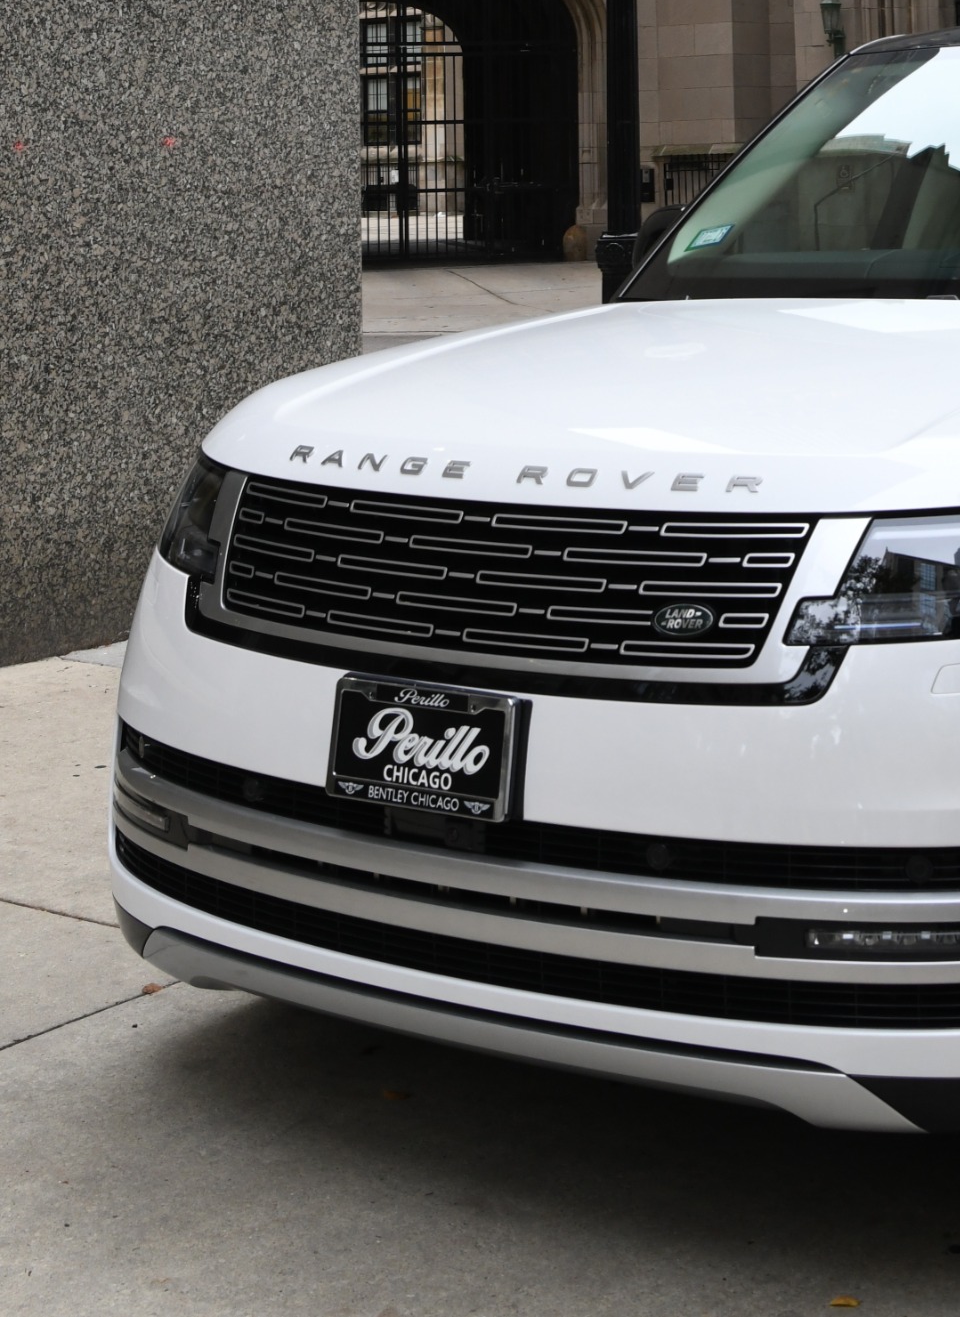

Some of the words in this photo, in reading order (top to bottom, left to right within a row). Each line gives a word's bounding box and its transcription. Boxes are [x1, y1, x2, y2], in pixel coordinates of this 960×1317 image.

[289, 444, 471, 480] RANGE
[516, 465, 764, 494] ROVER
[665, 609, 695, 618] LAND
[666, 619, 703, 628] ROVER
[394, 688, 450, 708] Perillo
[352, 707, 490, 775] Perillo
[382, 764, 452, 790] CHICAGO
[368, 785, 410, 804] BENTLEY
[411, 792, 459, 811] CHICAGO
